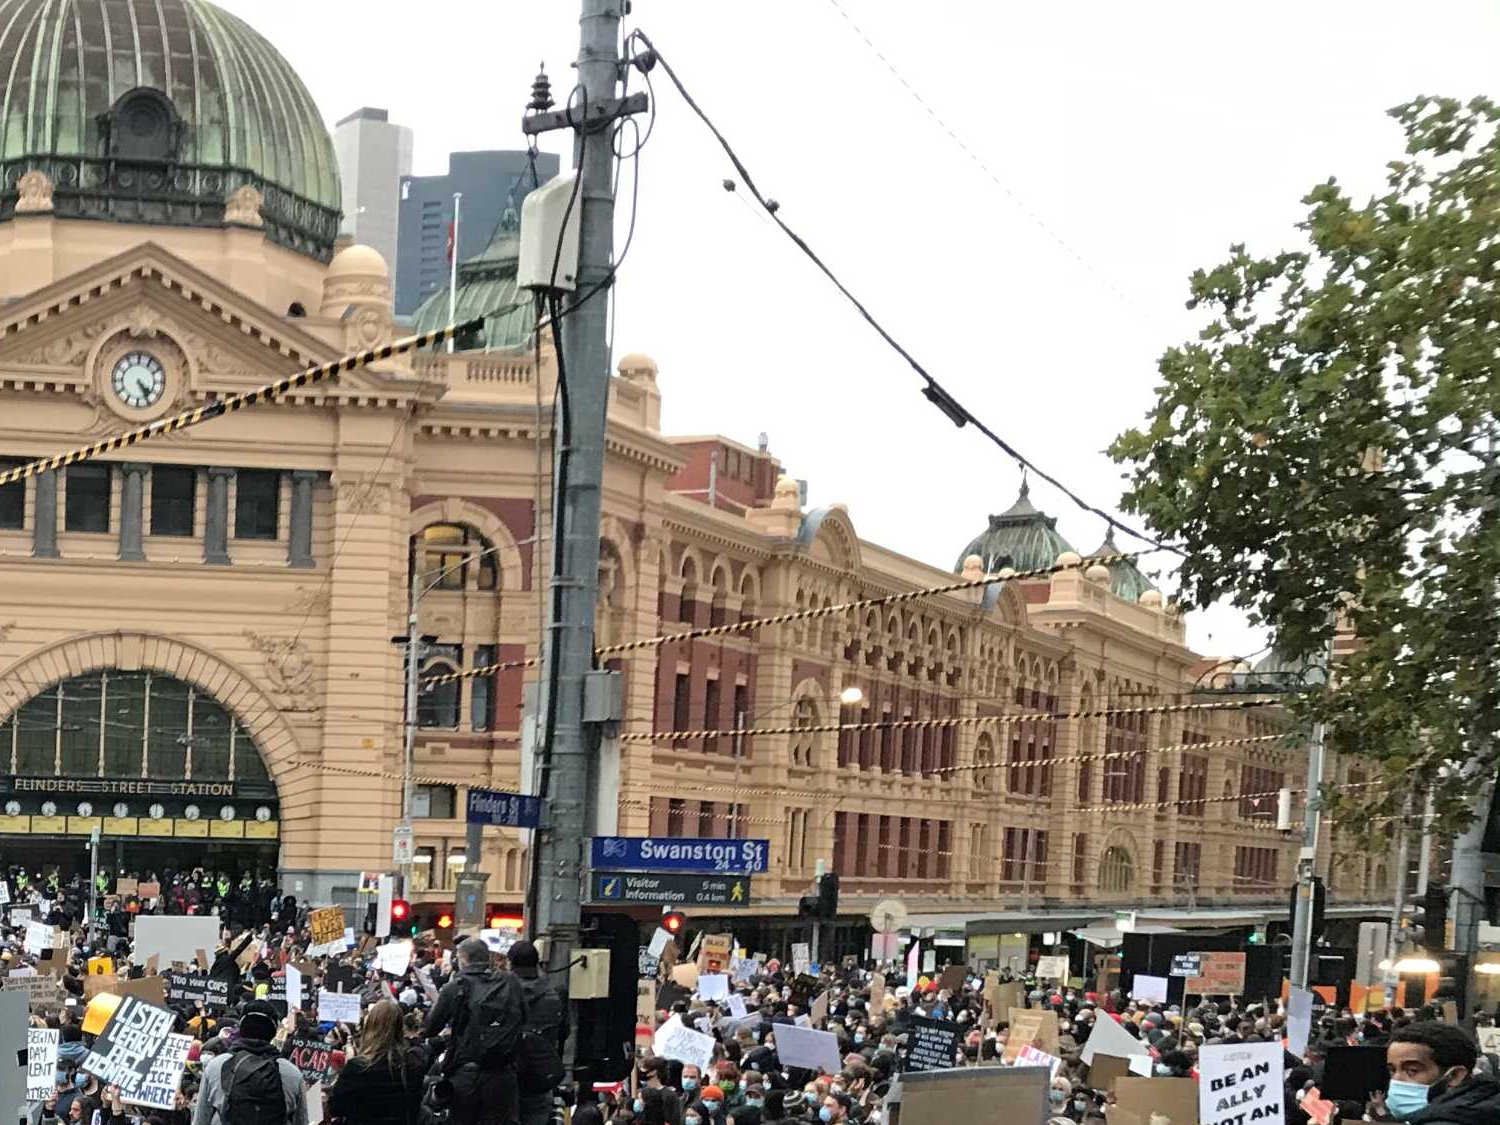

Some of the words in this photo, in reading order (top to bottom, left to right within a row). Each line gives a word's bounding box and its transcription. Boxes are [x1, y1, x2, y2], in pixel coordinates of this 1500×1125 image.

[15, 778, 84, 793] FLINDERS
[101, 780, 153, 794] STREET
[171, 782, 233, 796] STATION
[470, 792, 507, 815] Flinders
[509, 795, 519, 817] St
[640, 840, 736, 860] Swanston
[742, 842, 763, 861] St
[715, 860, 729, 870] 24
[626, 877, 660, 888] Visitor
[710, 881, 726, 890] min
[626, 890, 684, 901] Information
[172, 975, 186, 986] TOO
[207, 980, 228, 993] COPS
[116, 996, 177, 1040] LISTEN
[28, 1031, 57, 1045] BEGIN
[108, 1023, 163, 1058] LEARN
[292, 1040, 304, 1048] NO
[29, 1046, 47, 1058] DAY
[107, 1044, 145, 1071] ACT
[290, 1047, 329, 1073] ACAB
[82, 1051, 144, 1094] DONATE
[172, 1060, 185, 1071] TO
[1210, 1073, 1236, 1093] BE
[1240, 1062, 1270, 1082] AN
[1216, 1084, 1266, 1112] ALLY
[1250, 1103, 1279, 1121] AN
